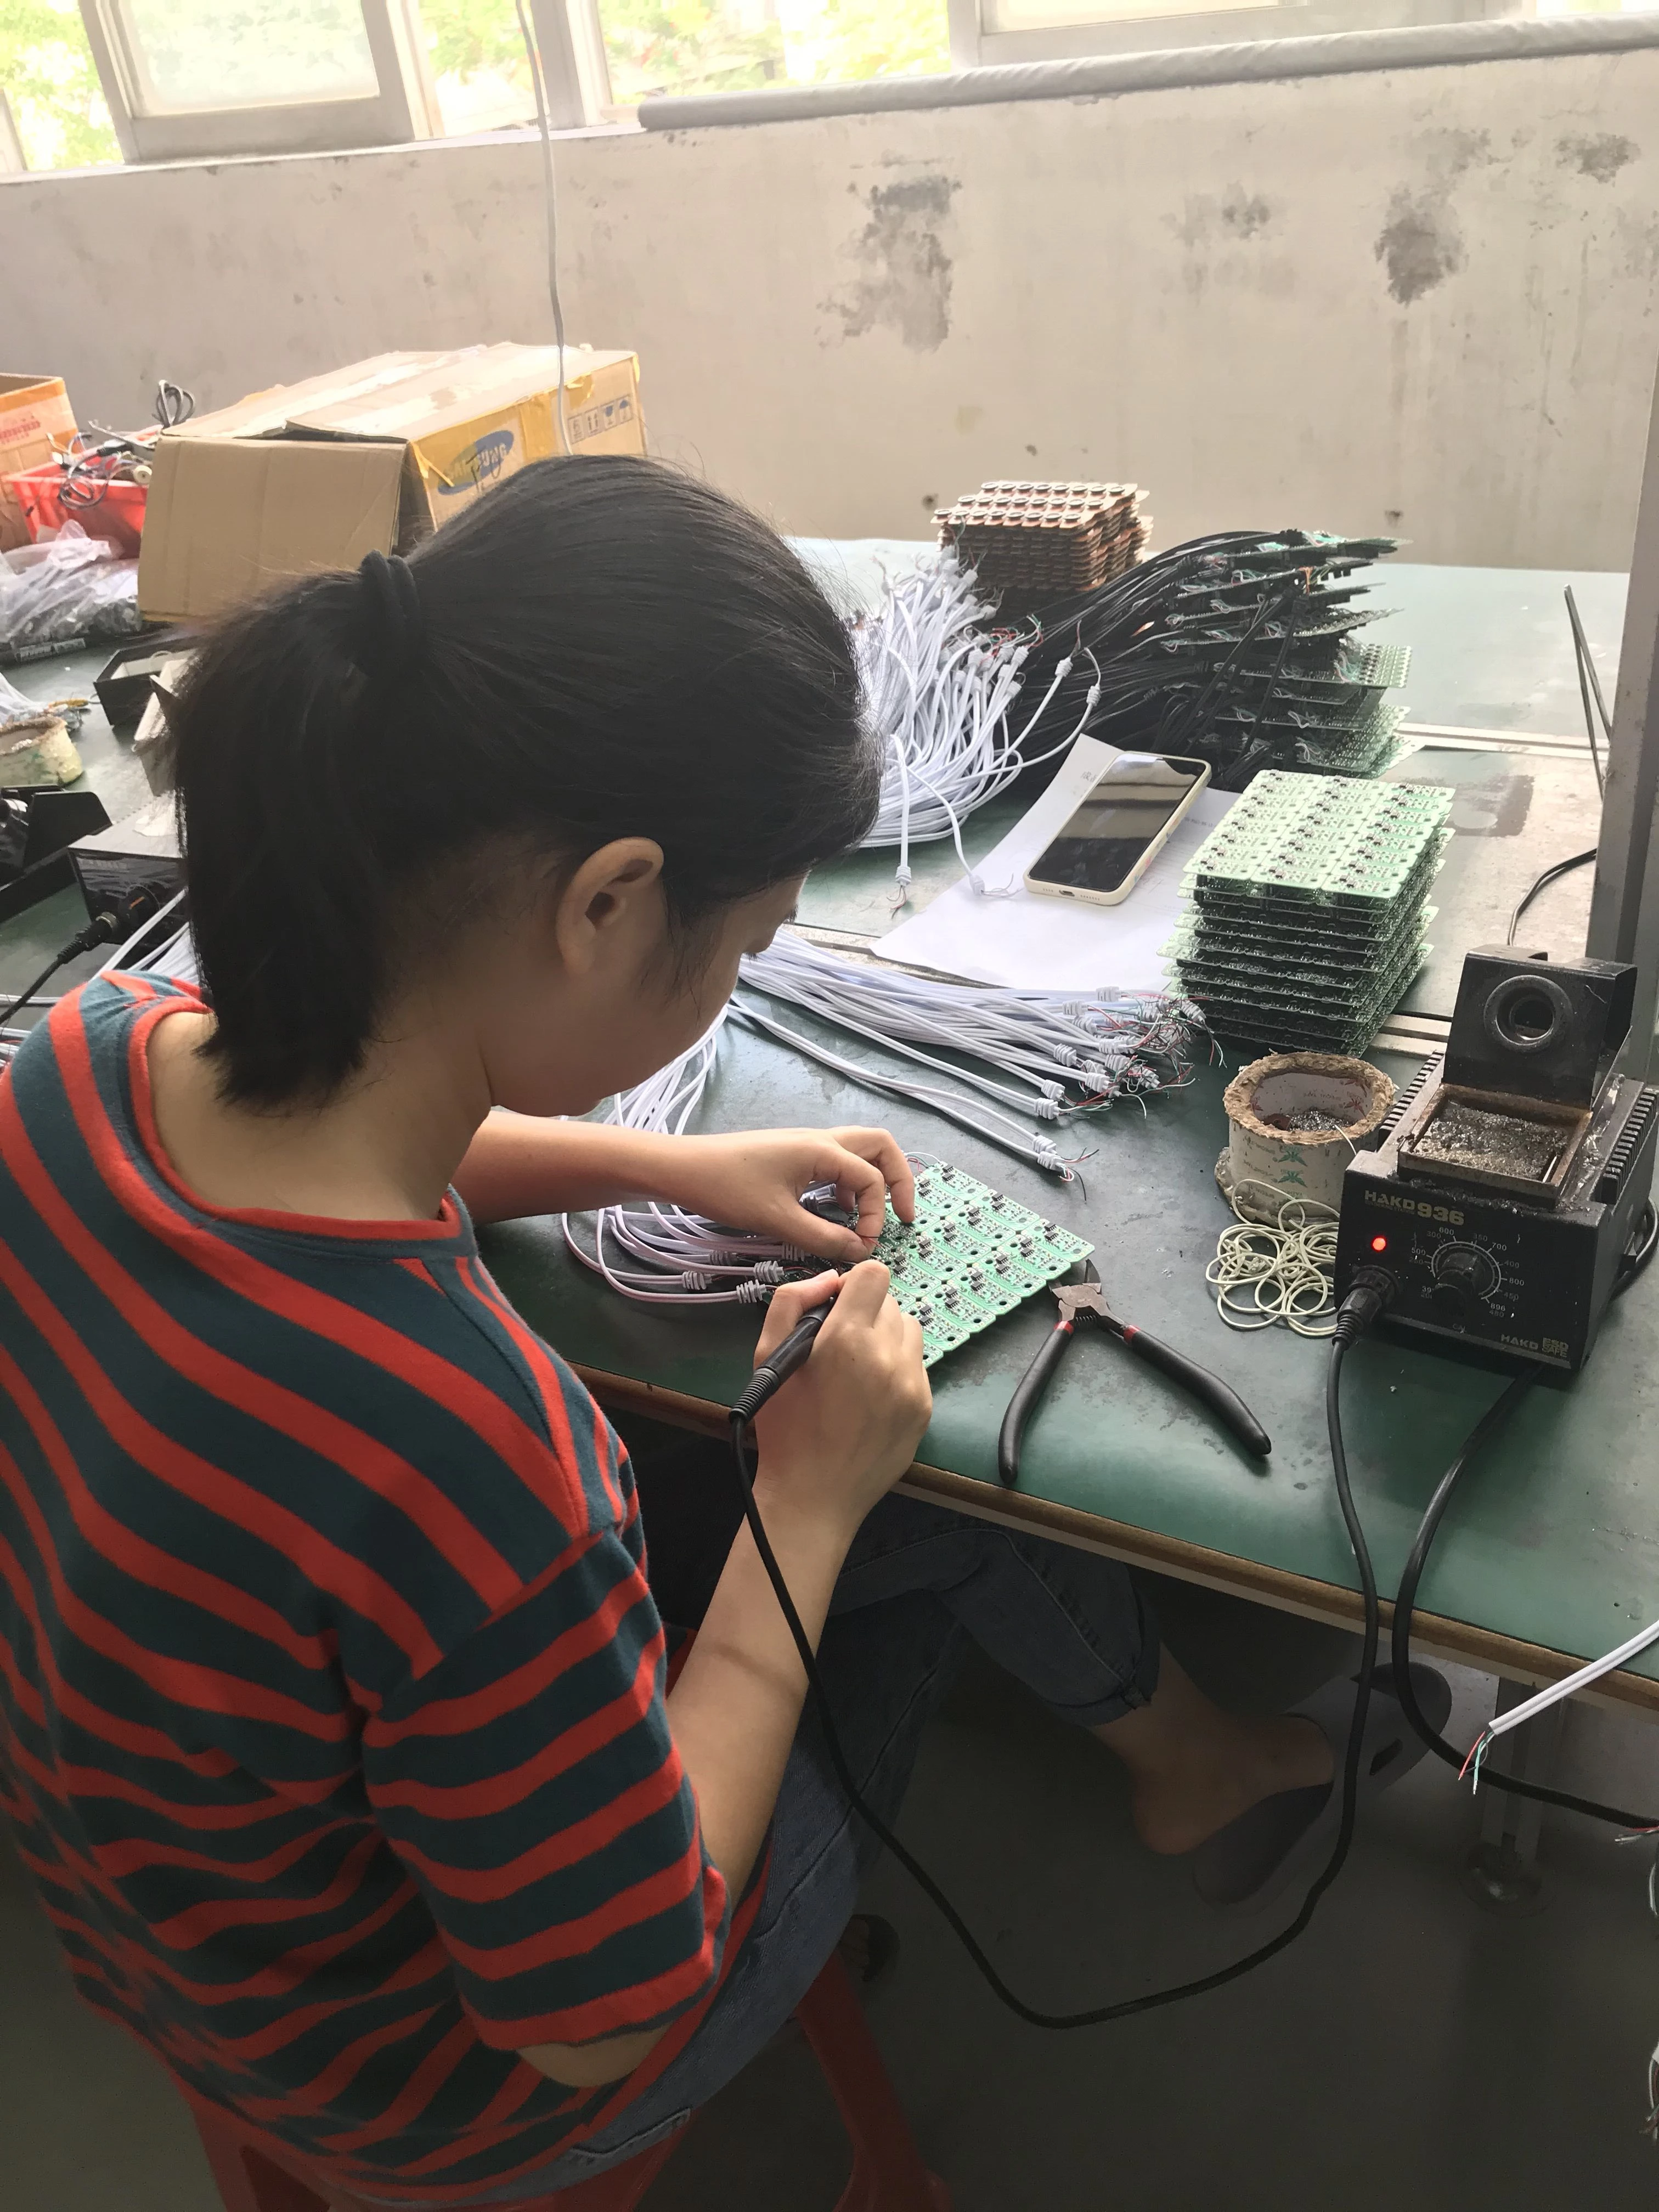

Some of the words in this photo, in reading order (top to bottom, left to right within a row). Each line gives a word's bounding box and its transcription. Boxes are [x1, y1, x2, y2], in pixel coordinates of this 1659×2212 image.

[1417, 1202, 1464, 1226] 936
[1427, 1231, 1441, 1239] 300
[1439, 1227, 1454, 1235] 600
[1411, 1246, 1426, 1256] 500
[1492, 1242, 1507, 1251] 700
[1509, 1277, 1525, 1286] 800
[1490, 1302, 1506, 1312] 896
